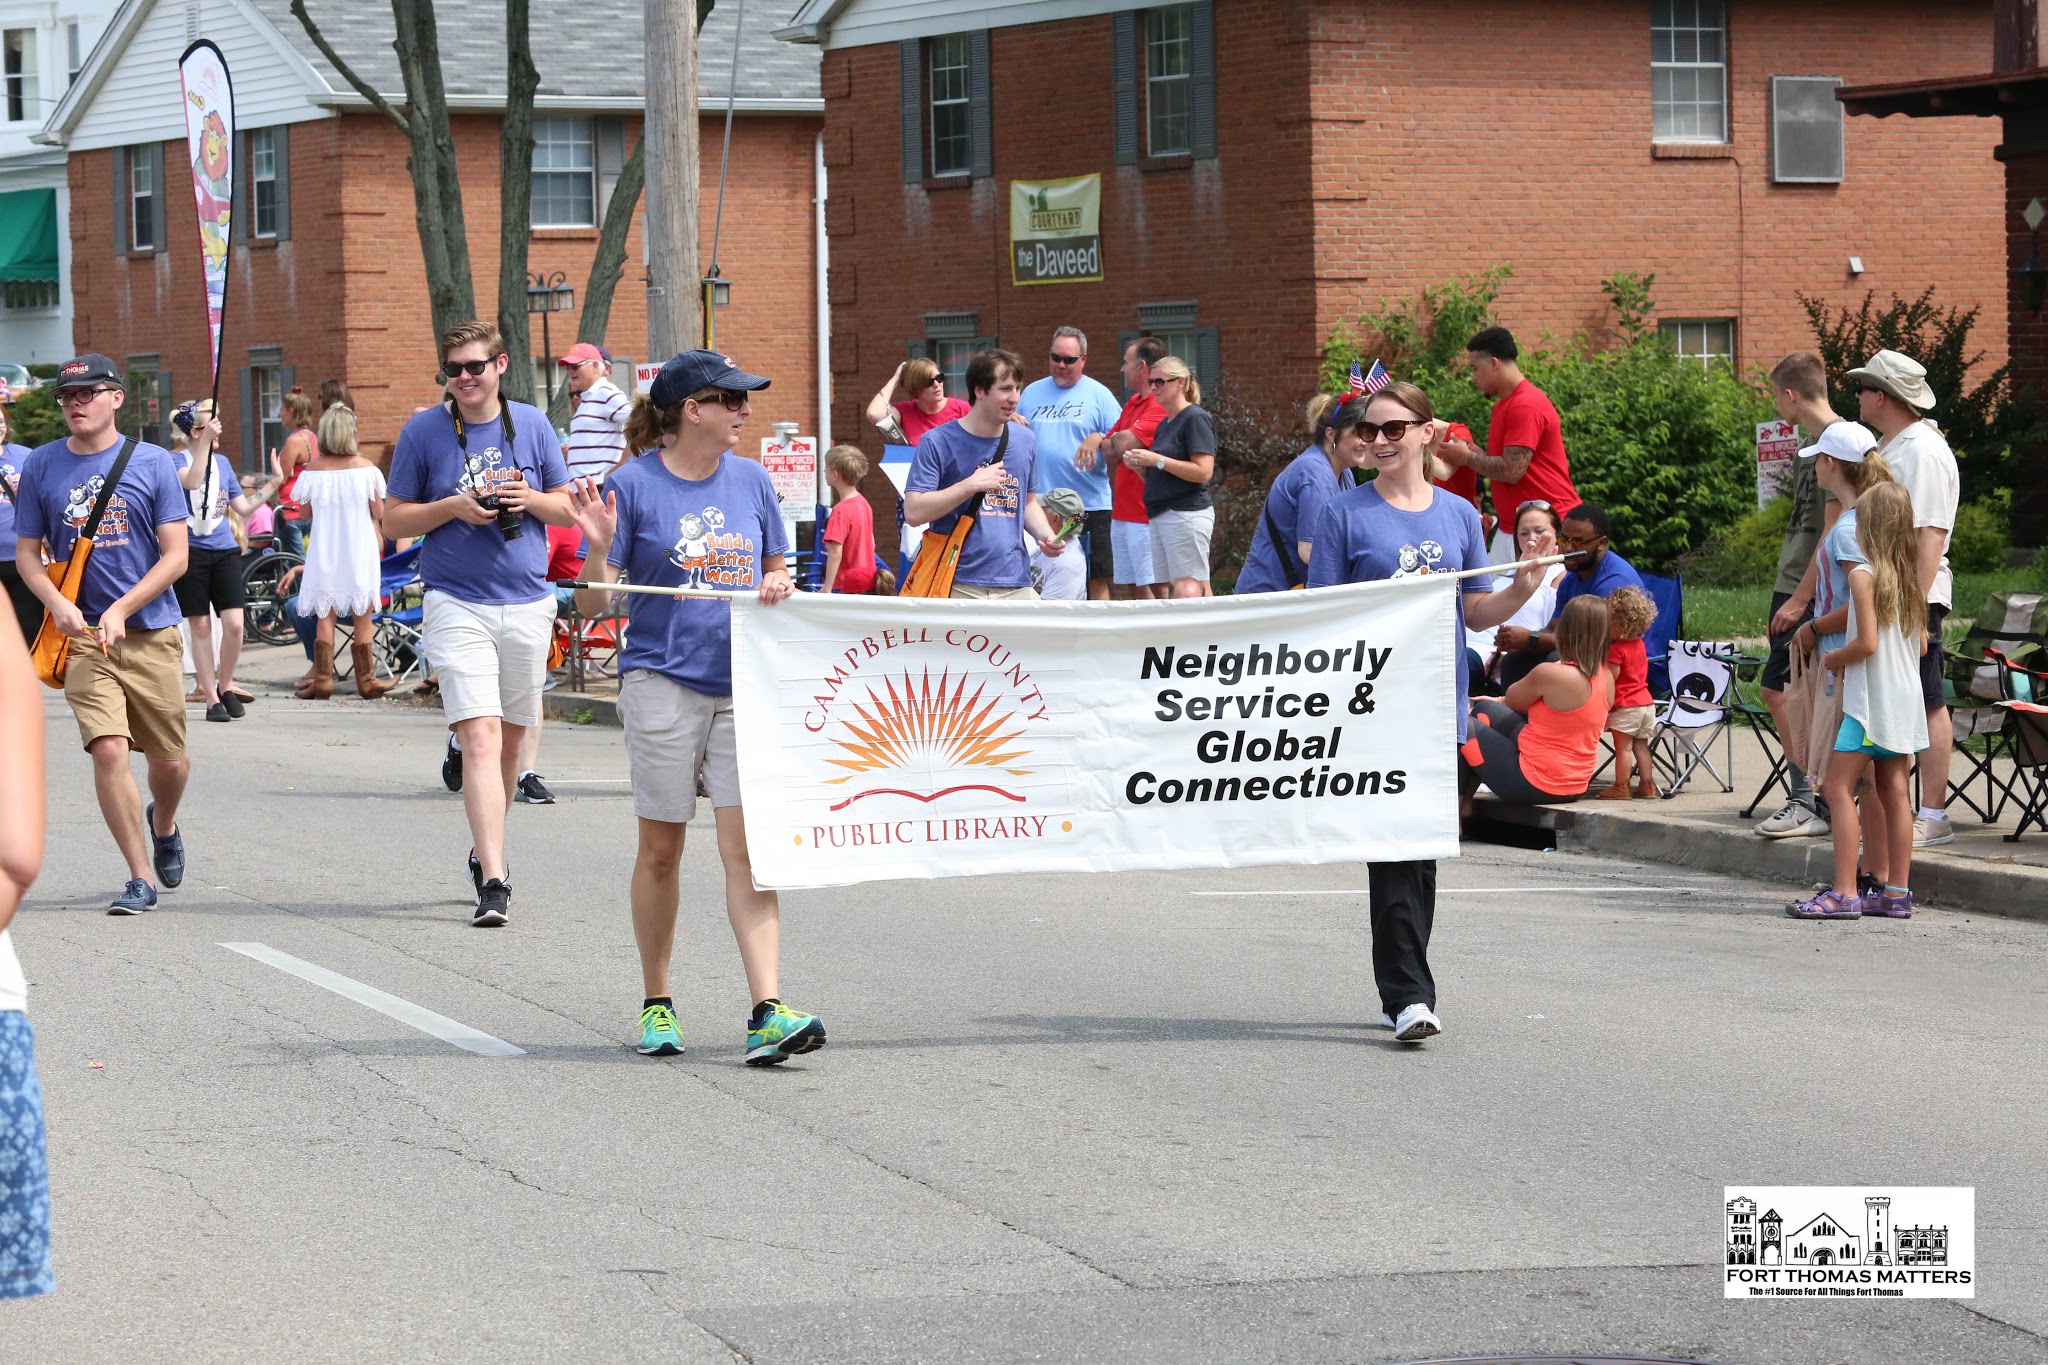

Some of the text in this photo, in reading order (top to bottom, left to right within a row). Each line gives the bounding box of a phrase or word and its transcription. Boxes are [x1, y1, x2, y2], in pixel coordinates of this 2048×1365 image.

[1031, 210, 1081, 228] COURTYARD
[1018, 239, 1098, 277] the Daveed
[65, 365, 89, 374] THOMAS
[637, 369, 650, 380] NO
[1030, 401, 1085, 420] Milt's
[764, 456, 814, 465] TOWING ENFORCED
[118, 497, 127, 508] a
[987, 496, 1018, 508] World
[100, 509, 127, 521] tter
[705, 532, 753, 552] Build a
[707, 550, 753, 568] Better
[704, 568, 753, 587] World
[1140, 640, 1393, 685] Neighborly
[804, 628, 1050, 733] CAMPBELL COUNTY
[1154, 682, 1376, 722] Service &
[1197, 726, 1342, 764] Global
[1125, 765, 1407, 805] Connections
[812, 815, 1048, 849] PUBLIC LIBRARY
